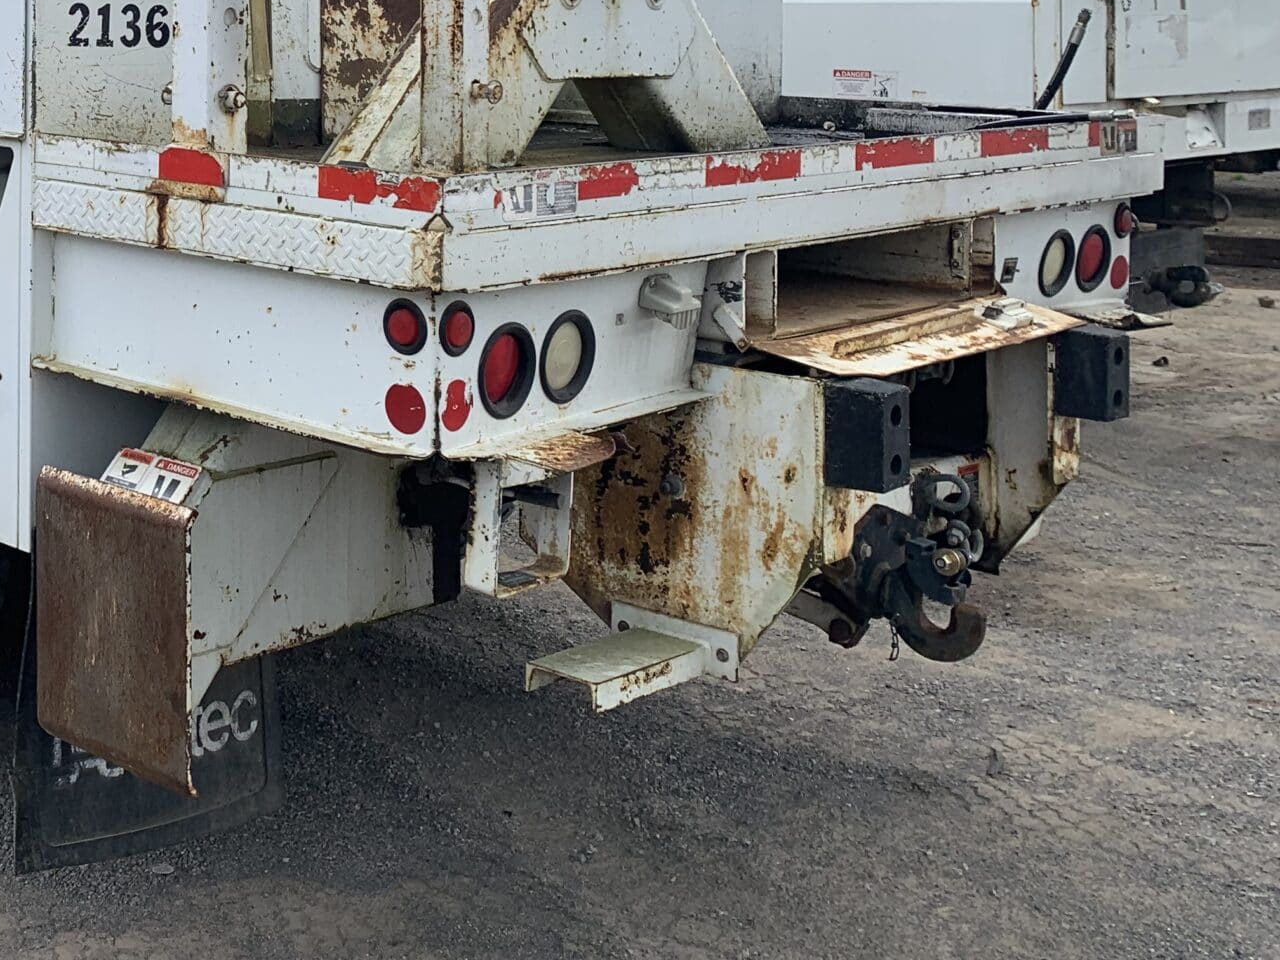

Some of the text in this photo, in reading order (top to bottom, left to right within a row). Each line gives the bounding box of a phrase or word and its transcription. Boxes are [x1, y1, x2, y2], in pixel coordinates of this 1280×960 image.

[67, 2, 171, 48] 2136
[166, 463, 197, 478] DANGER
[191, 690, 258, 756] tec
